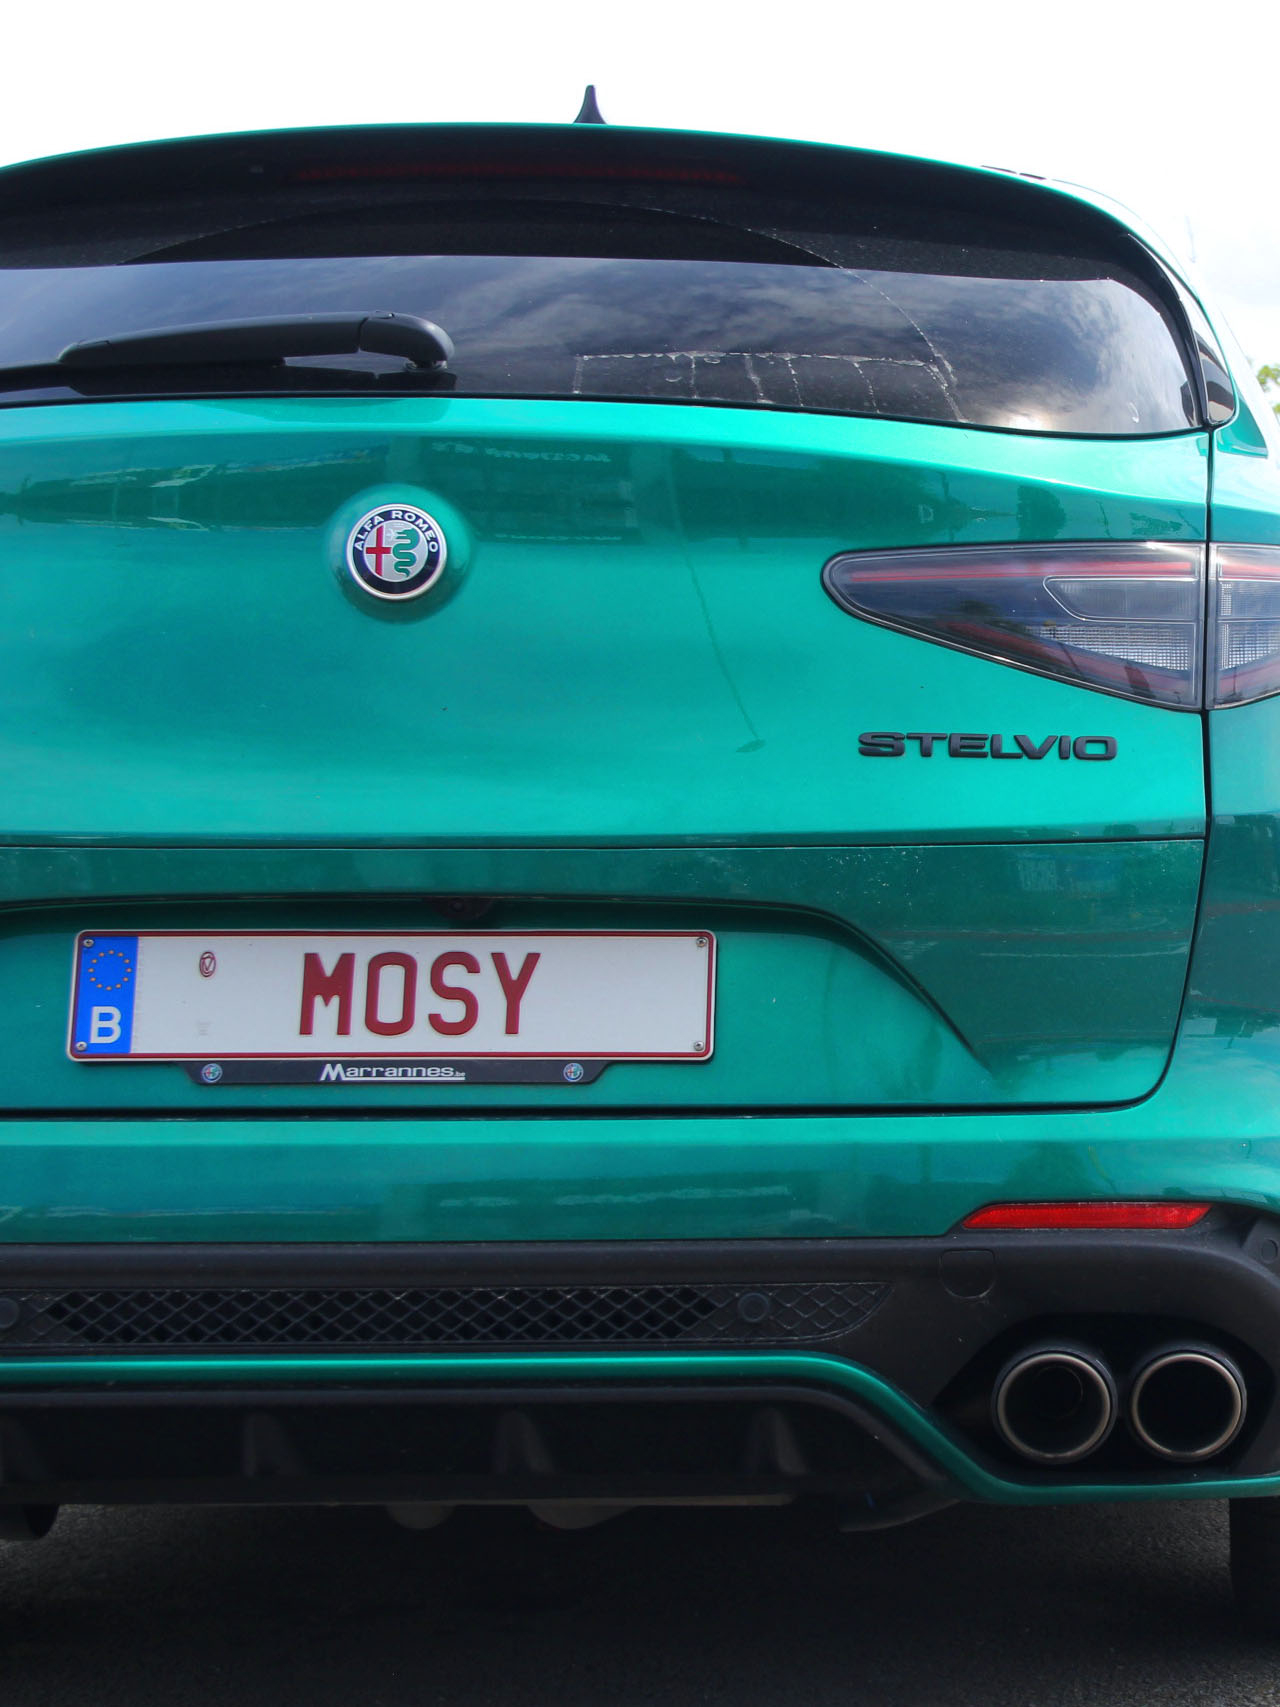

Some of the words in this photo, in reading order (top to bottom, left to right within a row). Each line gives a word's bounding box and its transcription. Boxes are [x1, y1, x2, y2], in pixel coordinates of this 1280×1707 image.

[354, 515, 384, 551] ALFA
[391, 510, 439, 553] ROMEO
[858, 732, 1117, 760] STELVIO
[300, 951, 541, 1036] MOSY
[90, 1006, 121, 1043] B
